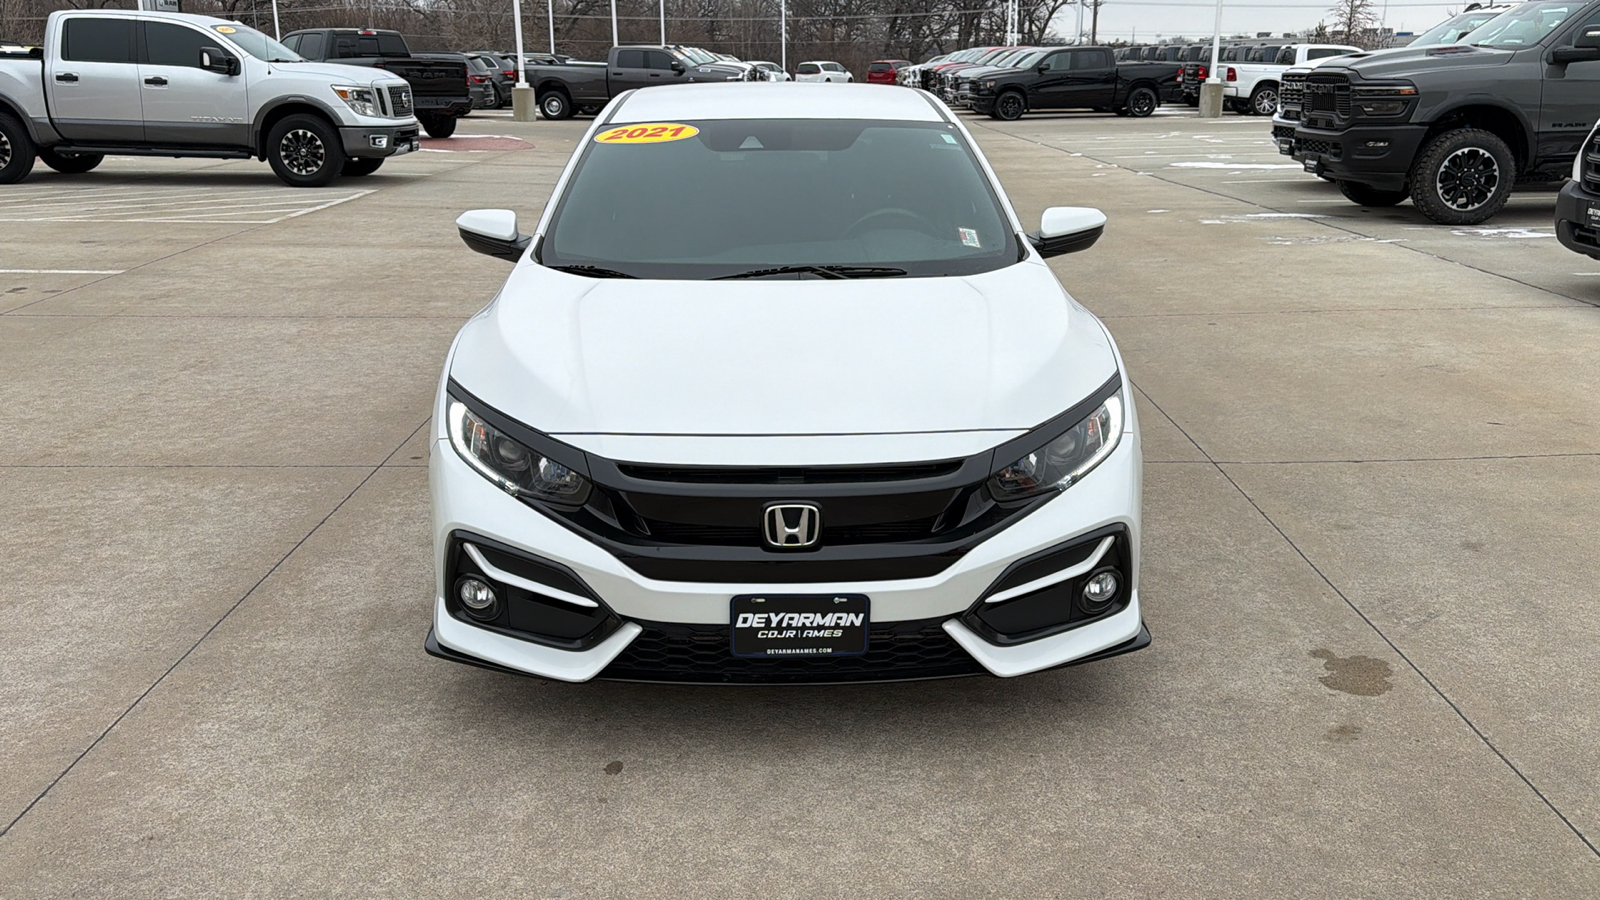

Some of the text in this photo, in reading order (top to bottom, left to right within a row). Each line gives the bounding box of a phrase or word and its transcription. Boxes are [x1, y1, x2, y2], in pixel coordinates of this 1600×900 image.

[604, 126, 687, 141] 2021
[735, 612, 865, 628] DEYARMAN
[757, 629, 844, 639] CDJR AMES
[766, 647, 832, 655] DEYARMANAMES.COM
